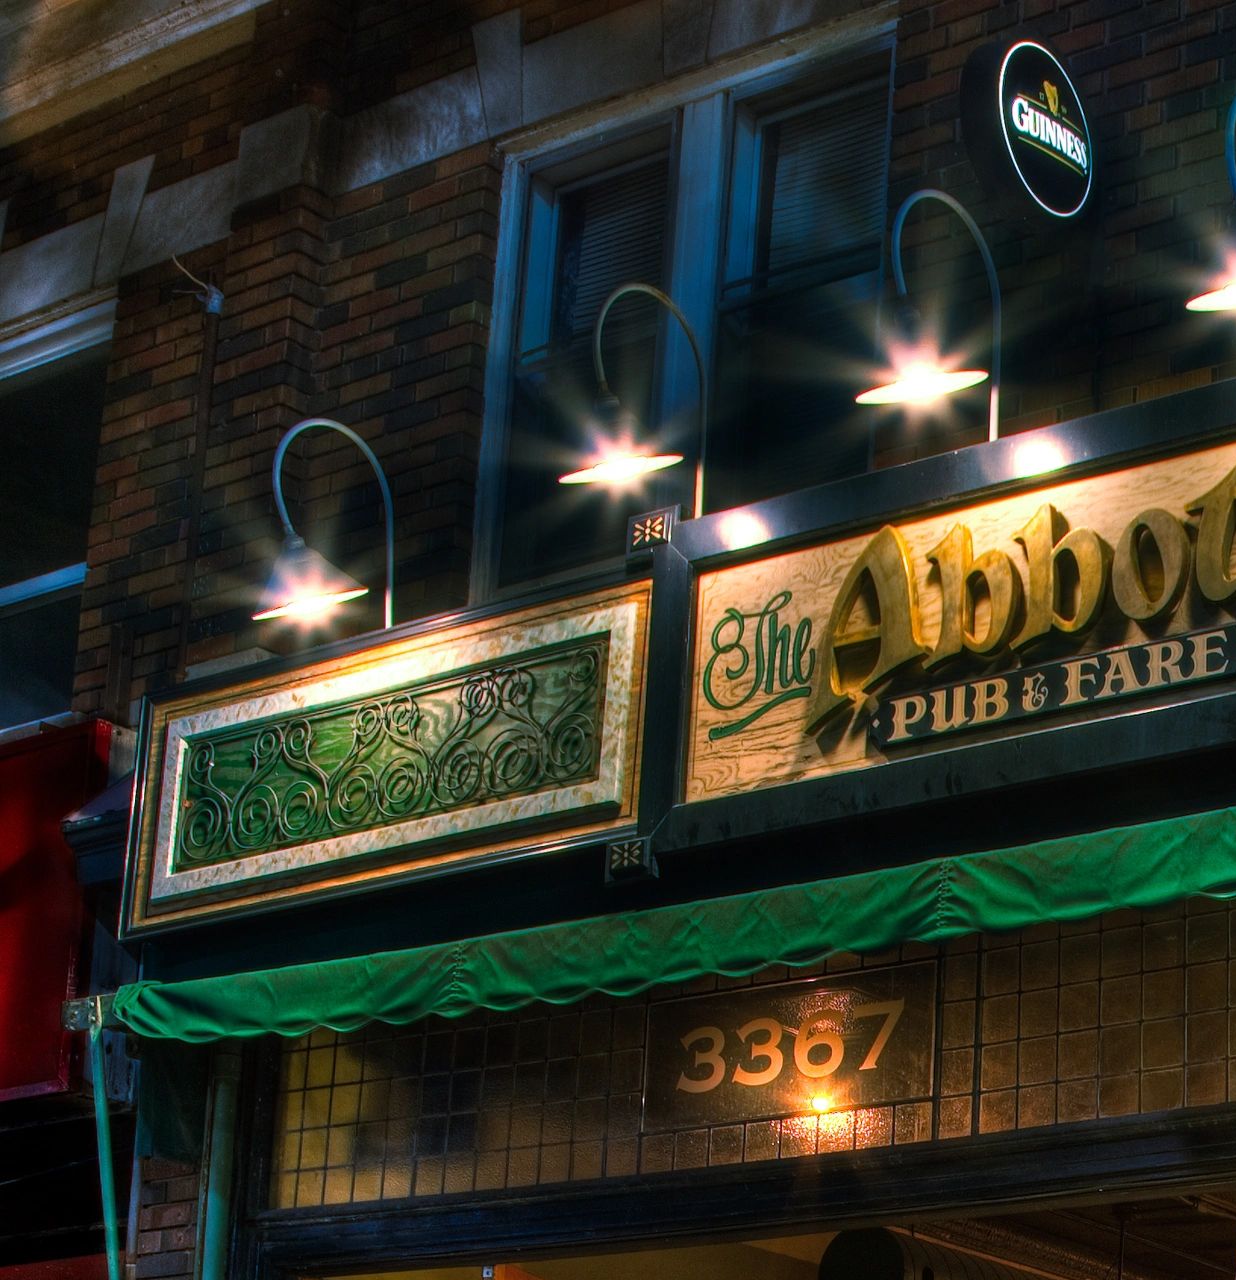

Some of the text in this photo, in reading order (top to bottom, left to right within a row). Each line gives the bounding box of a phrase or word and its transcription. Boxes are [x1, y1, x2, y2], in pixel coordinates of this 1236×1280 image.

[1011, 97, 1087, 169] GUINNESS
[703, 591, 816, 711] The
[886, 630, 1230, 742] PUB & FARE
[676, 998, 905, 1093] 3367
